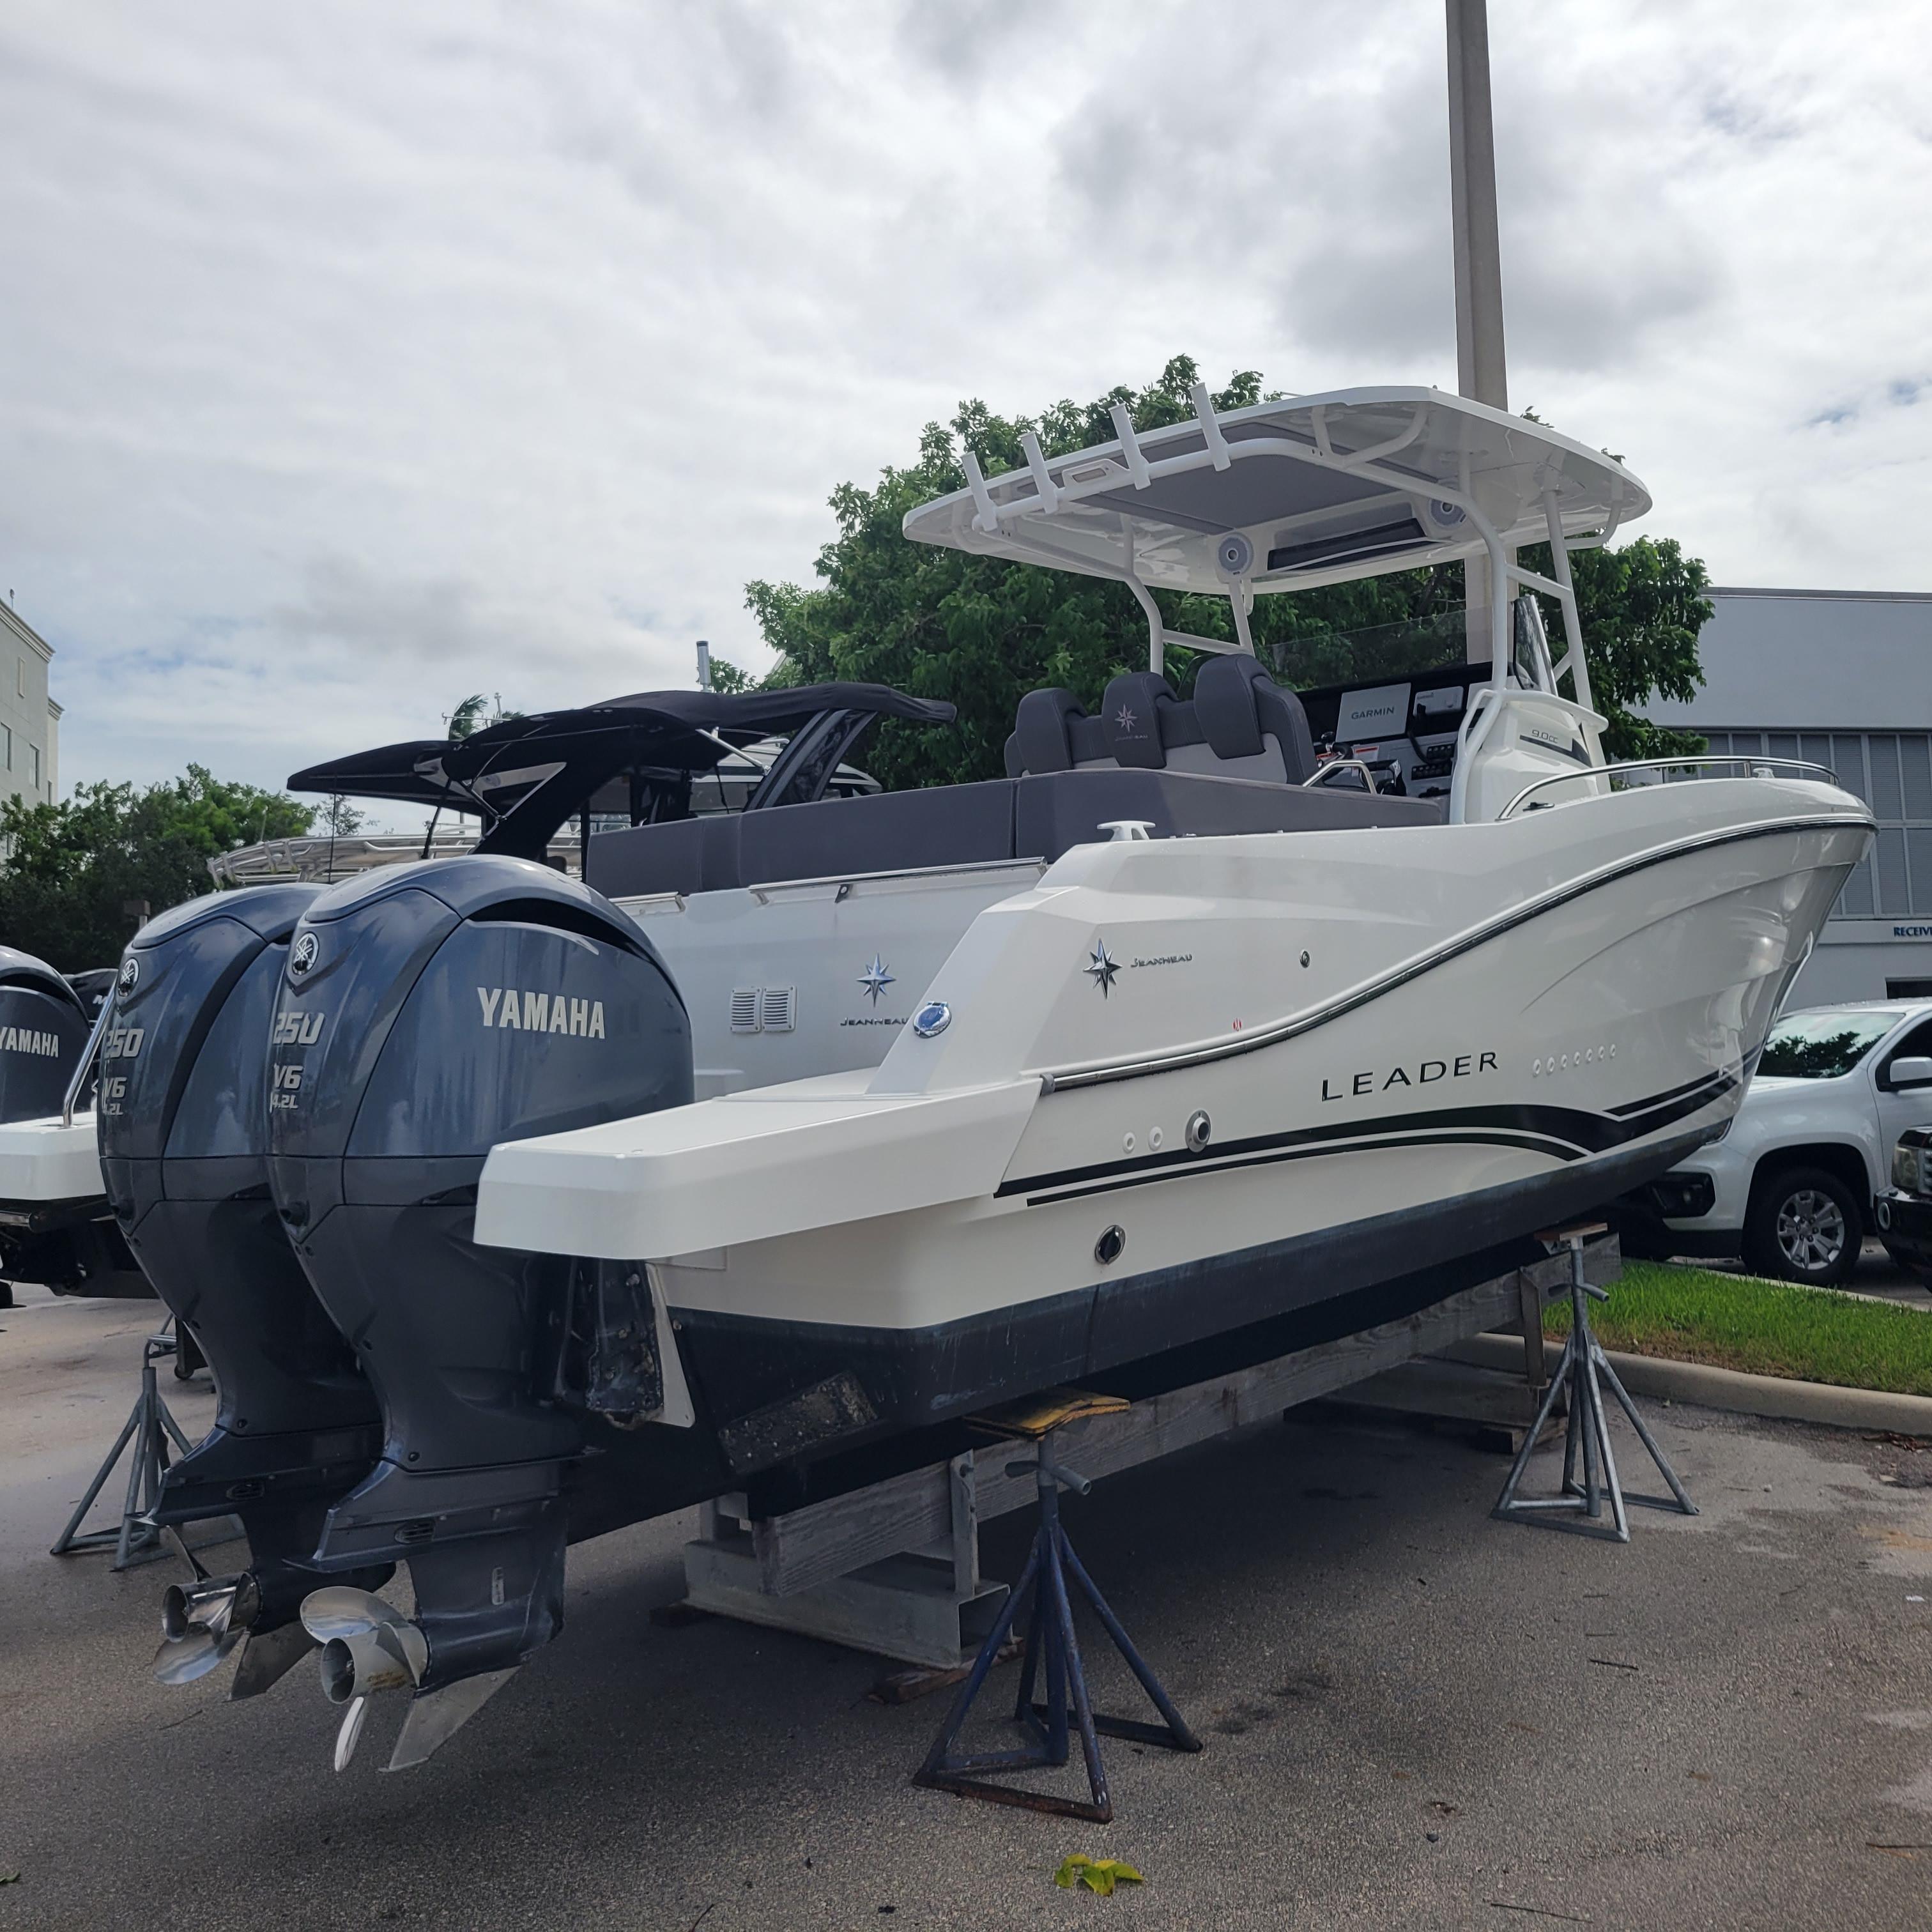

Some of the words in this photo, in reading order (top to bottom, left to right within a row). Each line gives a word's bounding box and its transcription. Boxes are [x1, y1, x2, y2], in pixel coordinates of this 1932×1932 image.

[1351, 707, 1395, 720] GARMIN
[1130, 954, 1193, 968] JEANNEAU
[477, 987, 605, 1039] YAMAHA
[0, 1027, 59, 1058] YAMAHA
[273, 1012, 325, 1045] 250
[105, 1029, 144, 1059] 250
[104, 1077, 127, 1098] V6
[274, 1063, 303, 1089] V6
[1322, 1052, 1498, 1102] LEADER
